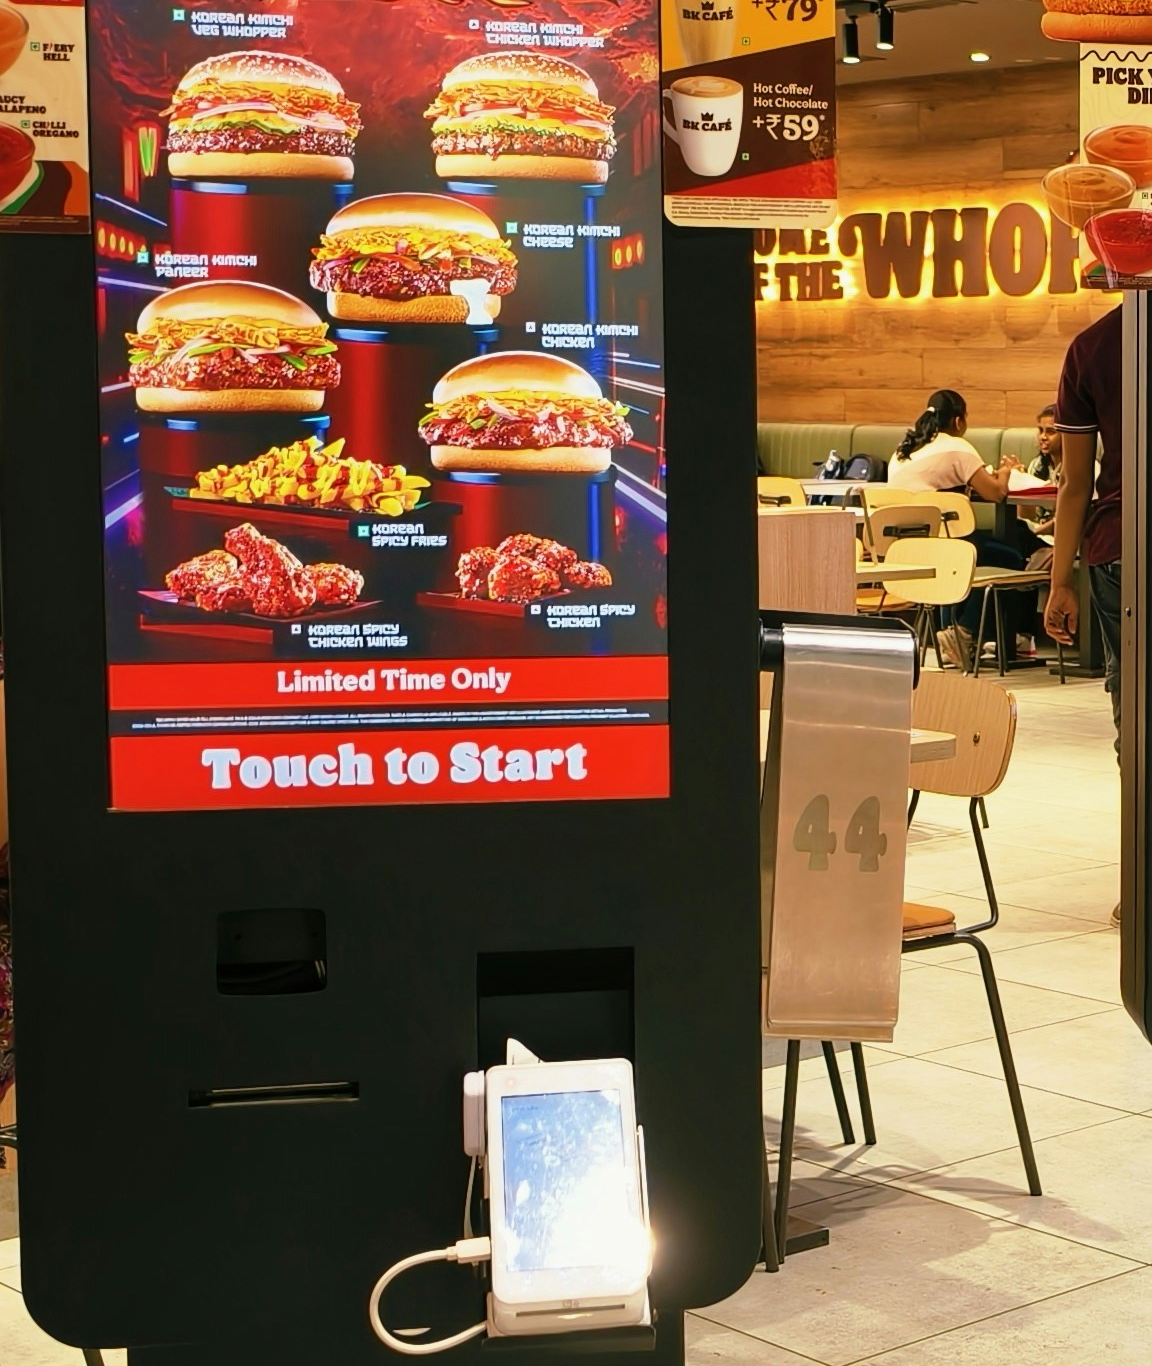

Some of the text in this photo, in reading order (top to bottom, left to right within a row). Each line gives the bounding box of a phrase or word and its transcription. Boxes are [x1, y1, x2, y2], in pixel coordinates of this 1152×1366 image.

[682, 6, 734, 21] BK CAFÉ
[1092, 67, 1144, 86] PICK
[753, 83, 814, 97] Hot Coffee/
[753, 96, 829, 110] Hot Chocolate
[682, 116, 732, 132] BK CAFÉ
[775, 261, 844, 302] THE
[276, 666, 512, 695] Limited Time Only
[201, 741, 589, 790] Touch to Start
[793, 793, 888, 873] 44
